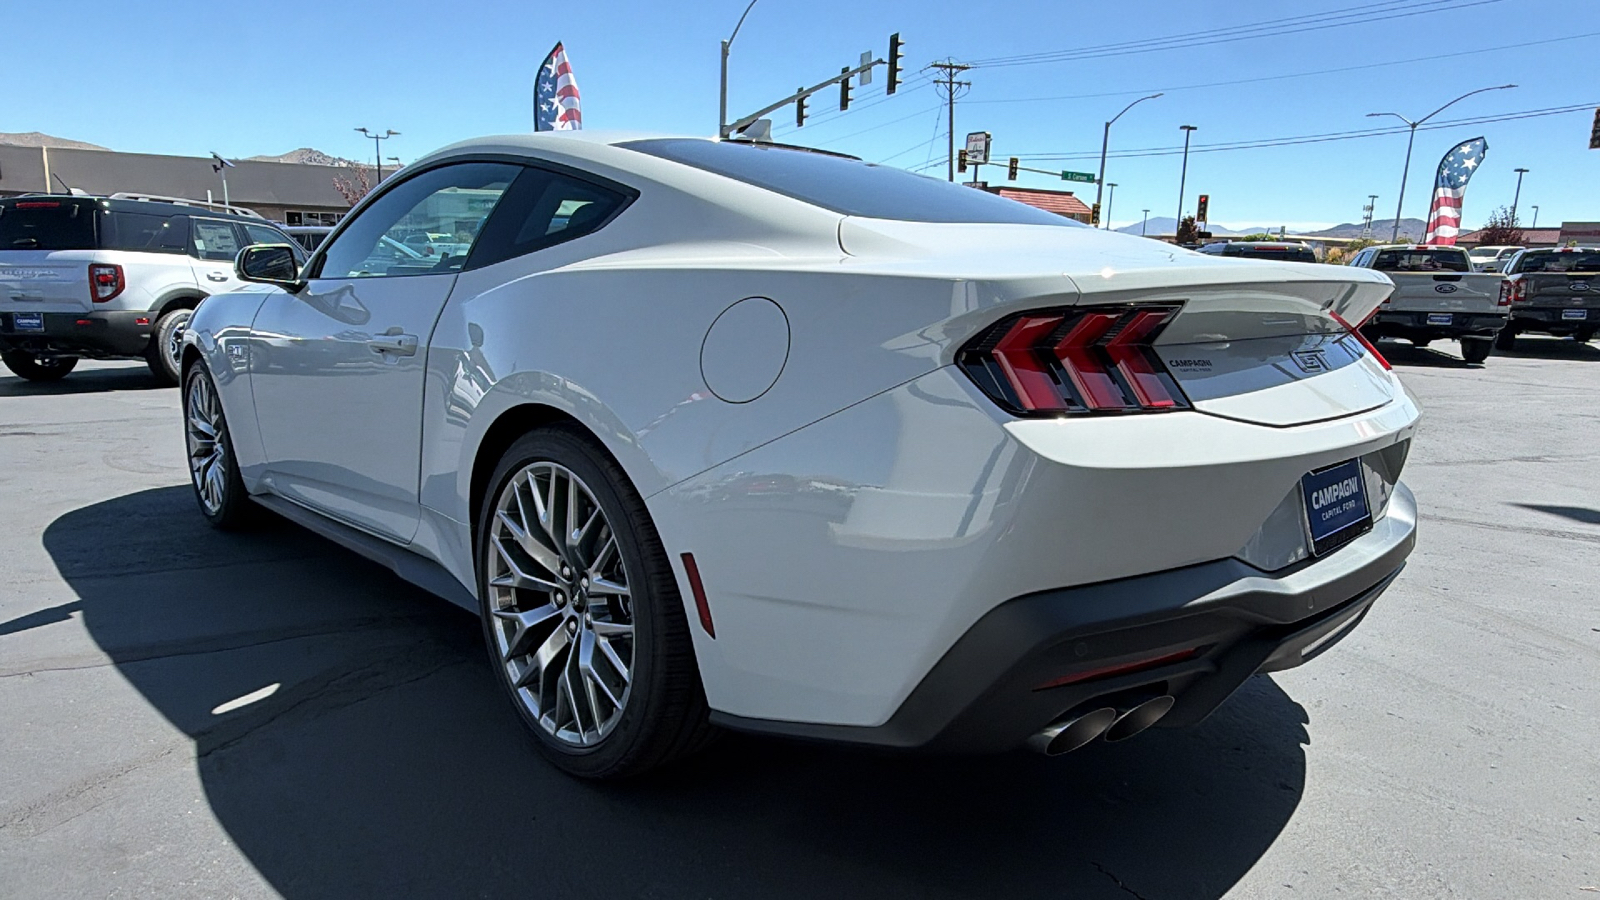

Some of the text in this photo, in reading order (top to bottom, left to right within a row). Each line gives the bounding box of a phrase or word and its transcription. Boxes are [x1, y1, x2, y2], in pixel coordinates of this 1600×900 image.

[1169, 359, 1212, 367] CAMPAGNI
[1288, 349, 1331, 373] GT
[1311, 476, 1359, 510] CAMPAGNI
[1321, 500, 1356, 520] CAPITAL FORD
